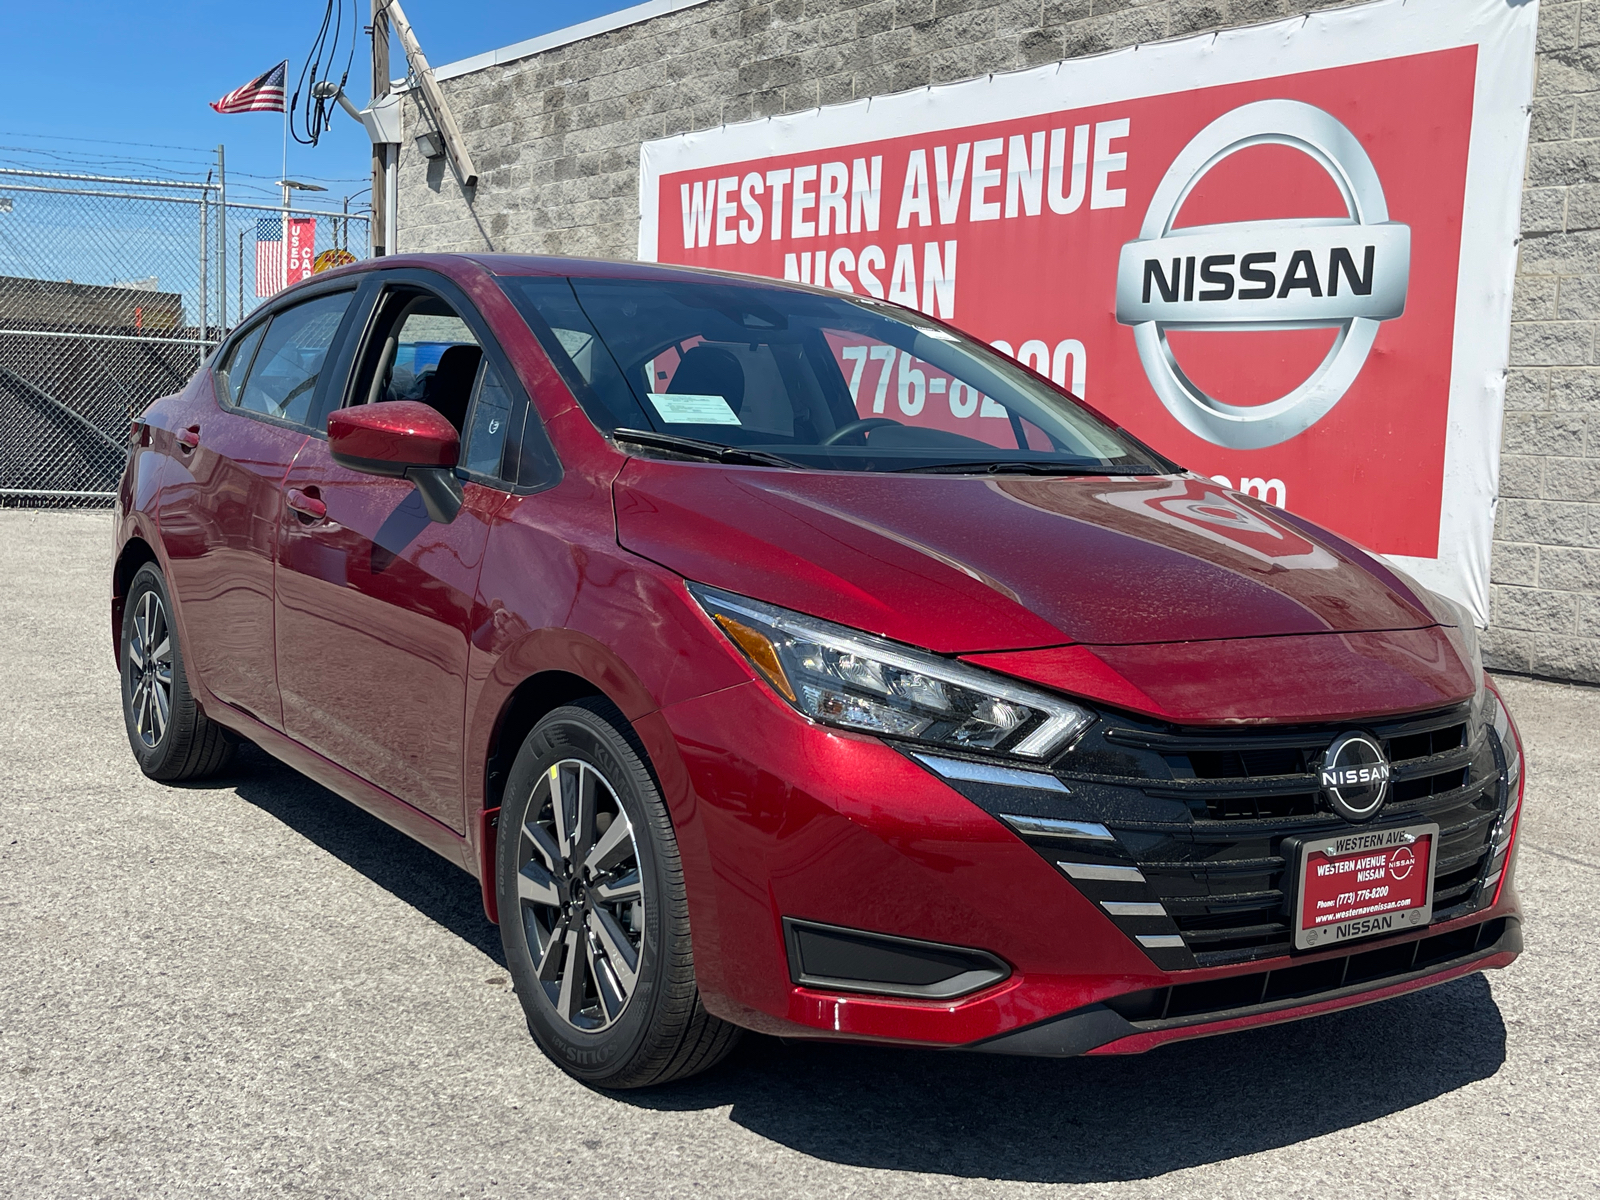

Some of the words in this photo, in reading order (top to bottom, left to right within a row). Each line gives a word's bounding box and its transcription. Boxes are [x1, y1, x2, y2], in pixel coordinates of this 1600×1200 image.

[680, 155, 883, 249] WESTERN
[896, 117, 1131, 229] AVENUE
[290, 225, 301, 270] USED
[1141, 245, 1376, 304] NISSAN
[1321, 765, 1390, 786] NISSAN
[1336, 835, 1384, 852] WESTERN
[1317, 860, 1355, 877] WESTERN
[1356, 855, 1387, 870] AVENUE
[1357, 867, 1386, 882] NISSAN
[1388, 858, 1415, 868] NISSAN
[1316, 900, 1335, 909] Phone:
[1336, 891, 1355, 908] (773)
[1356, 886, 1389, 901] 776-8200
[1315, 898, 1412, 924] www.westernavenissan.com
[1336, 915, 1393, 939] NISSAN
